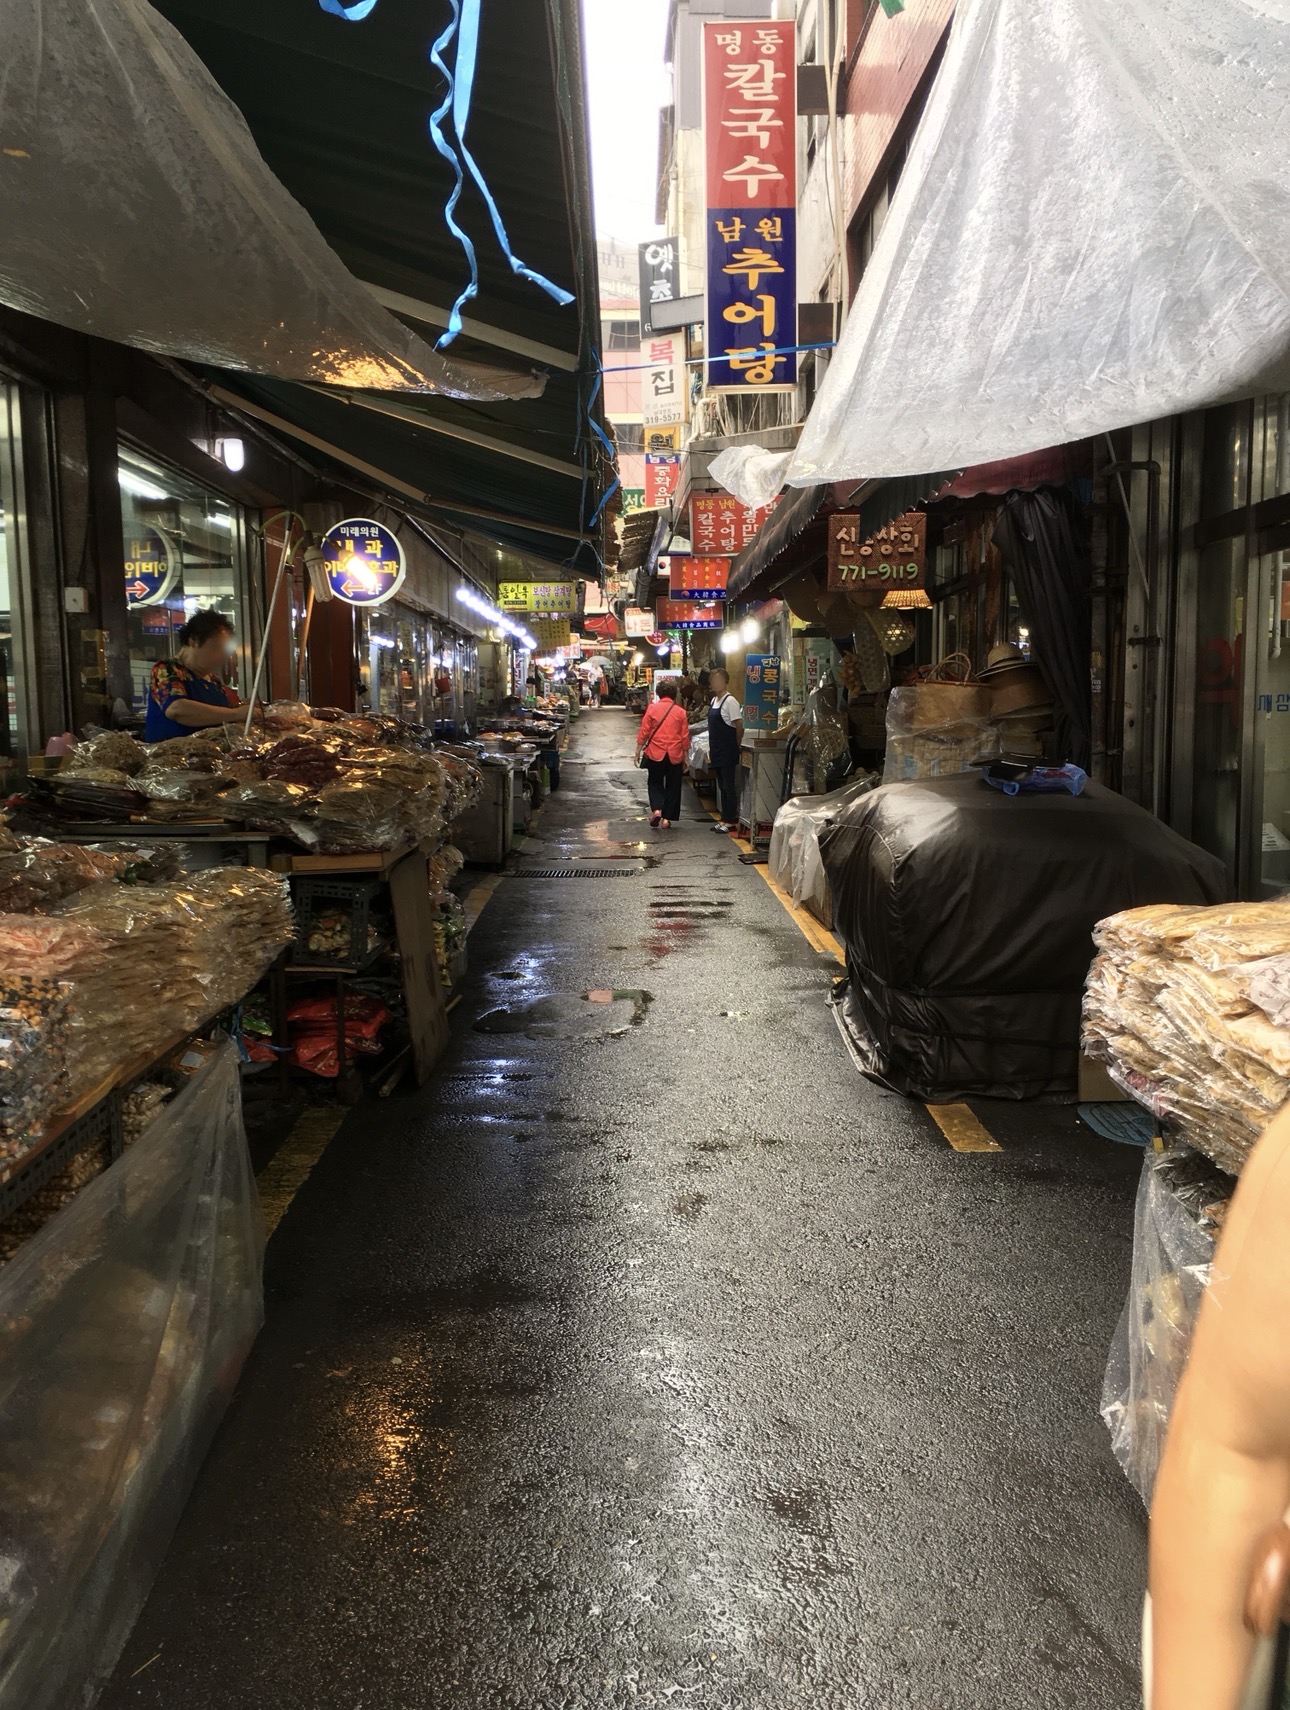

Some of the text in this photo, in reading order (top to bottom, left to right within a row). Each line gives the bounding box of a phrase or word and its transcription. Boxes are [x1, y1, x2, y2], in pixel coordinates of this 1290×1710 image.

[714, 30, 784, 56] 명동
[721, 59, 787, 199] 칼국수
[715, 217, 783, 243] 남원
[722, 248, 787, 384] 추어탕
[645, 413, 681, 425] 319-5577
[696, 499, 714, 510] 명동
[718, 499, 735, 510] 남원
[340, 526, 379, 538] 미래의원
[697, 512, 716, 552] 칼국수
[720, 511, 738, 551] 추어탕
[838, 563, 919, 581] 771-9119
[808, 658, 818, 677] 냉면
[745, 664, 761, 723] 냉면
[761, 668, 778, 725] 콩국수
